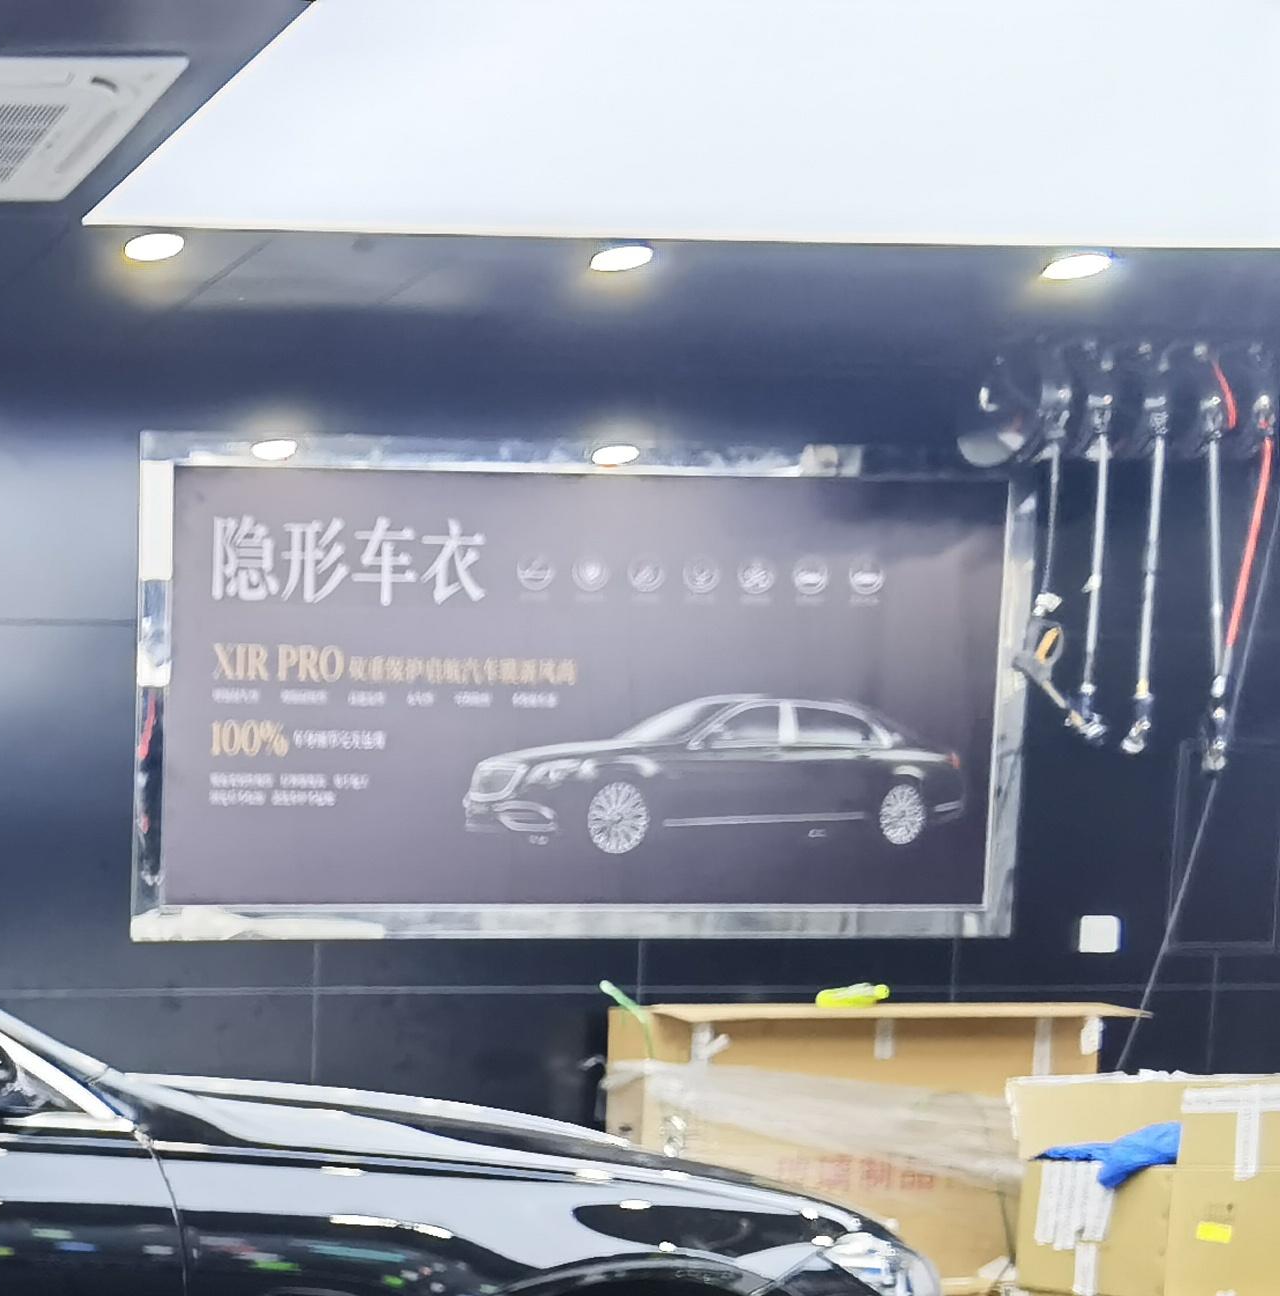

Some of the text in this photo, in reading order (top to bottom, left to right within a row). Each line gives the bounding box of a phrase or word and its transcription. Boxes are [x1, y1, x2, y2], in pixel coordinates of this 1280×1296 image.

[211, 514, 485, 605] 隐形车衣
[213, 643, 269, 682] XIR
[277, 644, 345, 683] PRO
[210, 720, 289, 758] 100%
